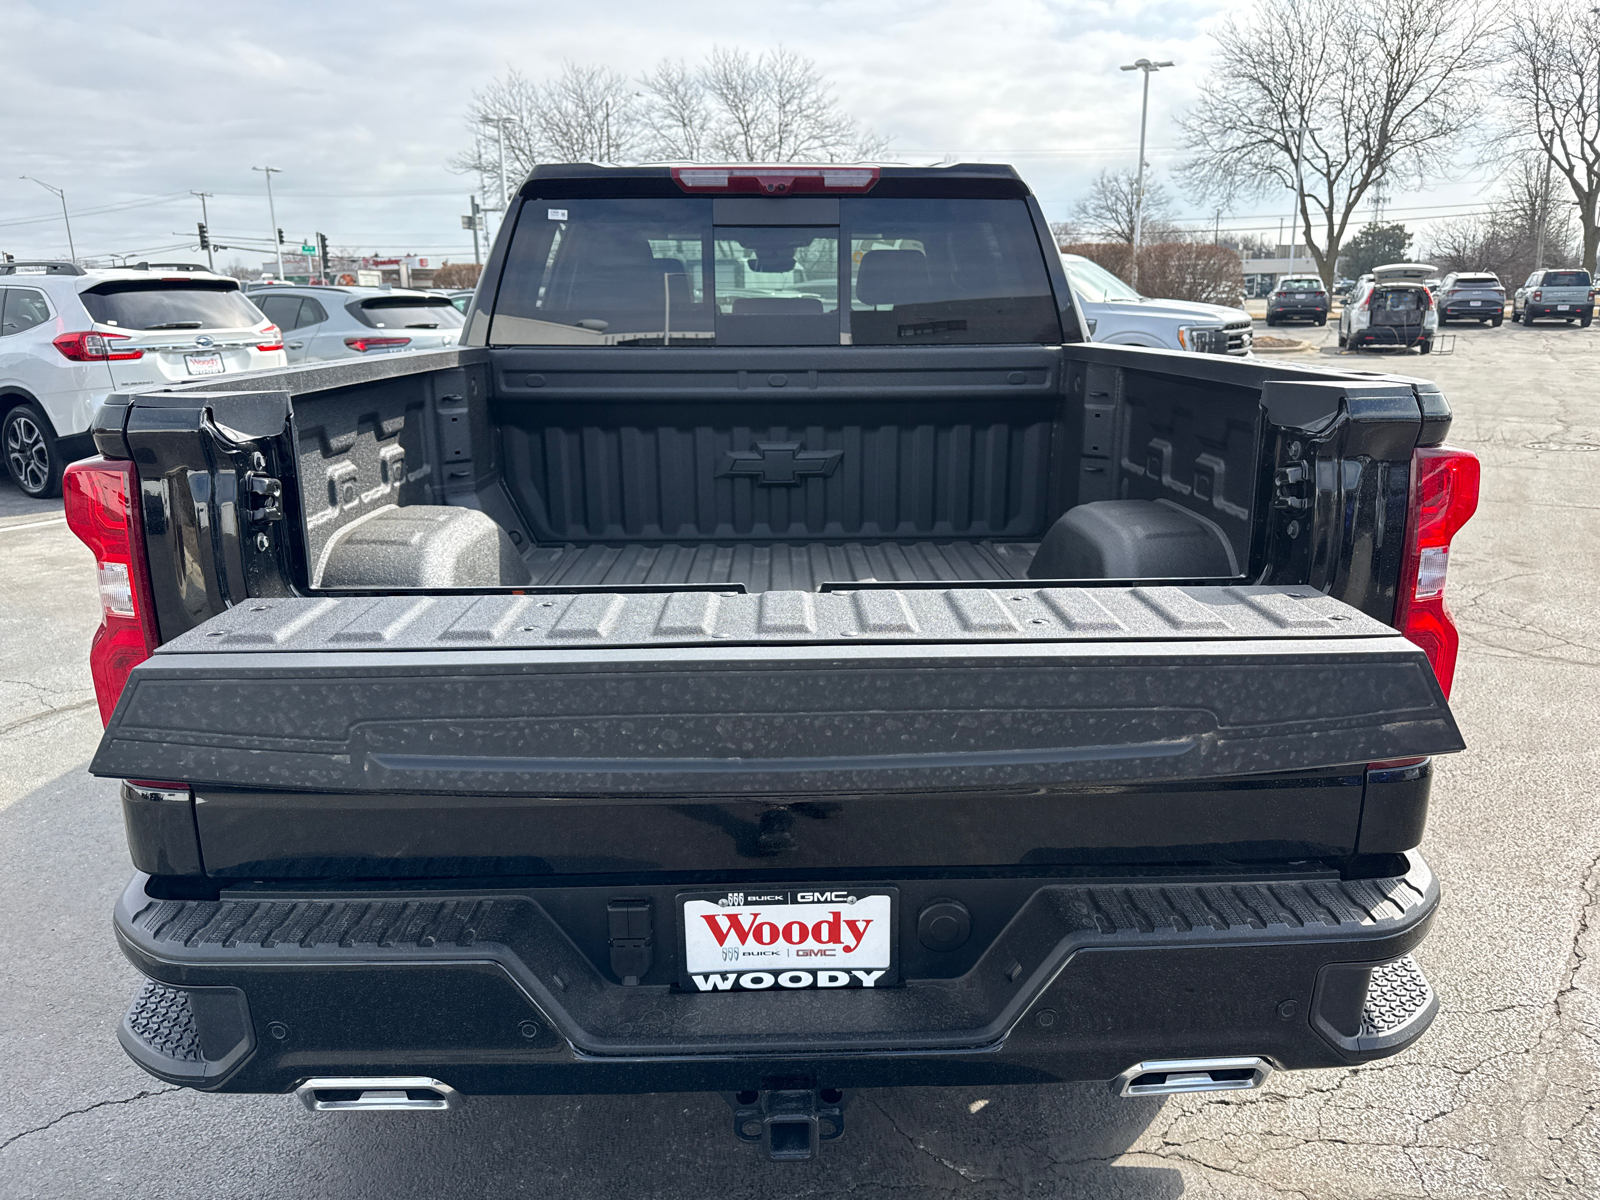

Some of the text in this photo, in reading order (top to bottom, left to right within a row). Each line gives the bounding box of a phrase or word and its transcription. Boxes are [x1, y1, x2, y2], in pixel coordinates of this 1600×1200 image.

[797, 891, 848, 902] GMC
[700, 911, 874, 954] Woody
[796, 949, 836, 957] GMC
[692, 970, 886, 991] WOODY
